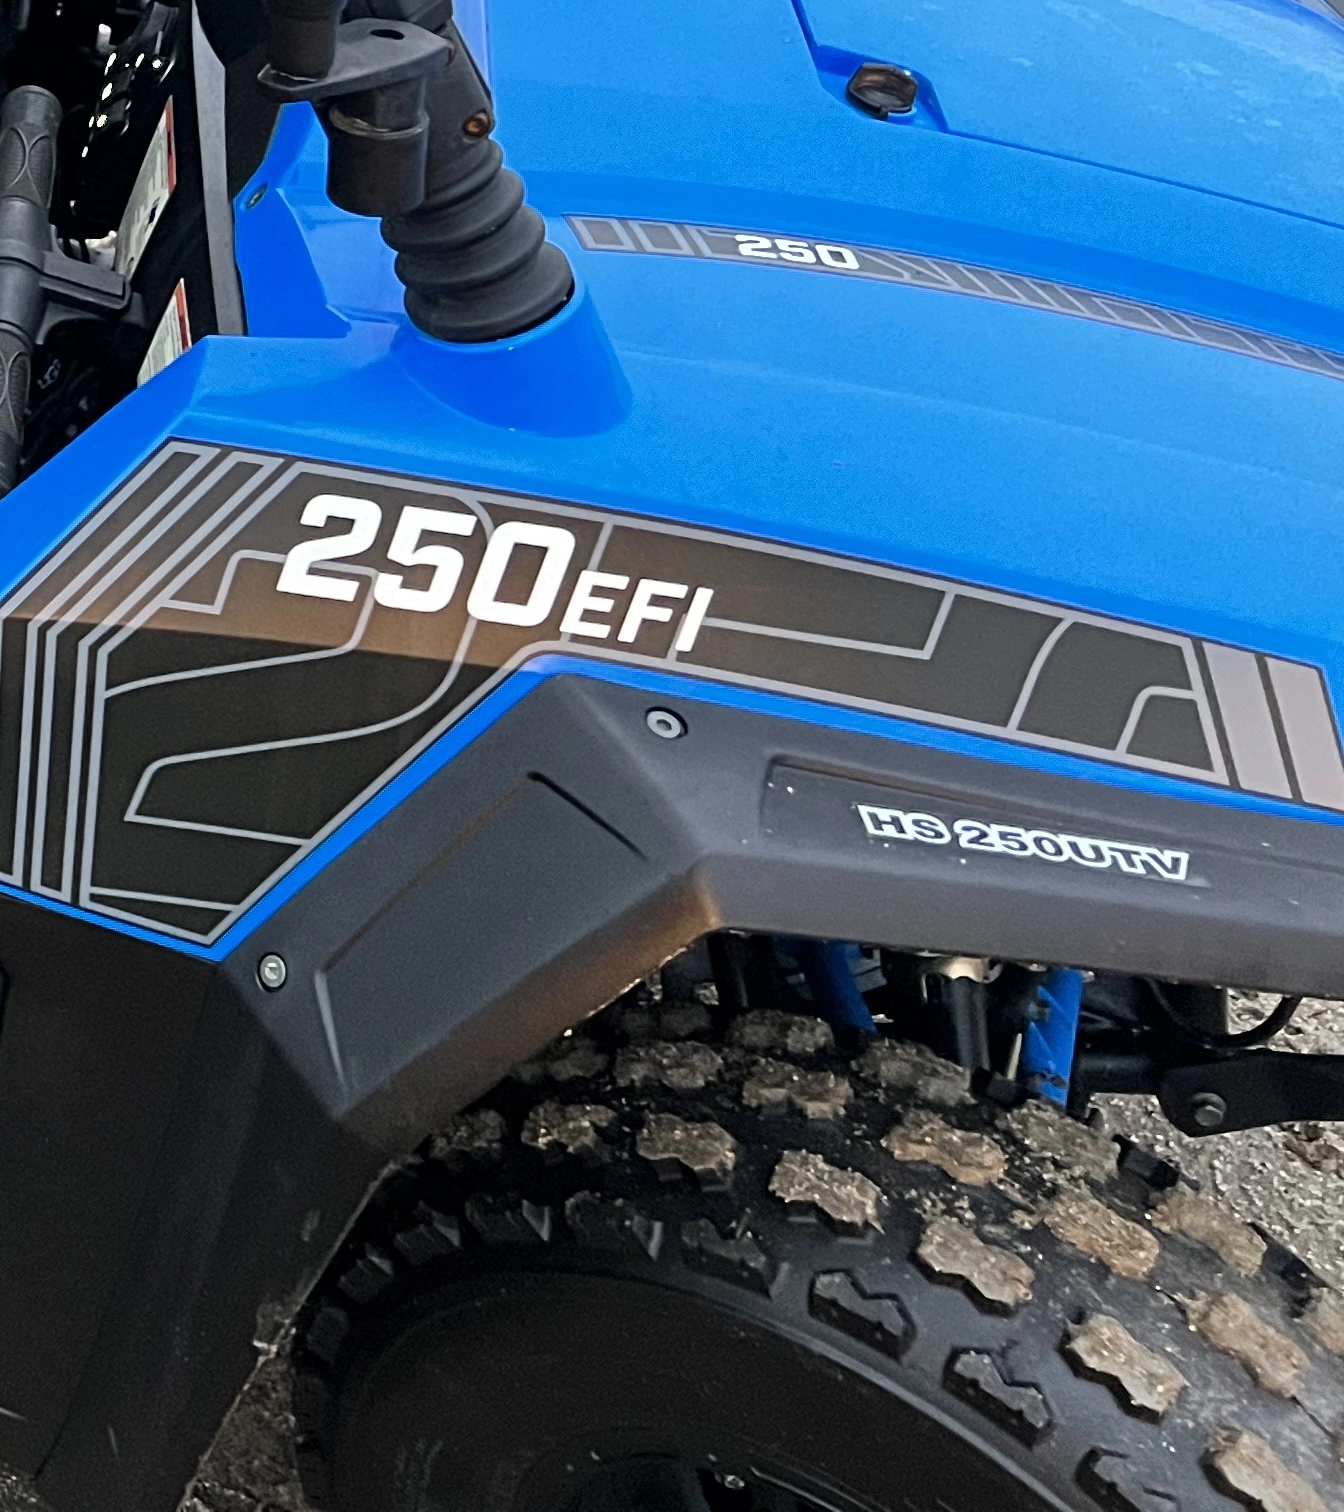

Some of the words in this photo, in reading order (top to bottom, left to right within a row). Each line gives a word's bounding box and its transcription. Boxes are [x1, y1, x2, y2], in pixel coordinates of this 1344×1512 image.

[735, 234, 860, 270] 250
[858, 804, 951, 844] HS
[953, 820, 1190, 881] 250UTV
